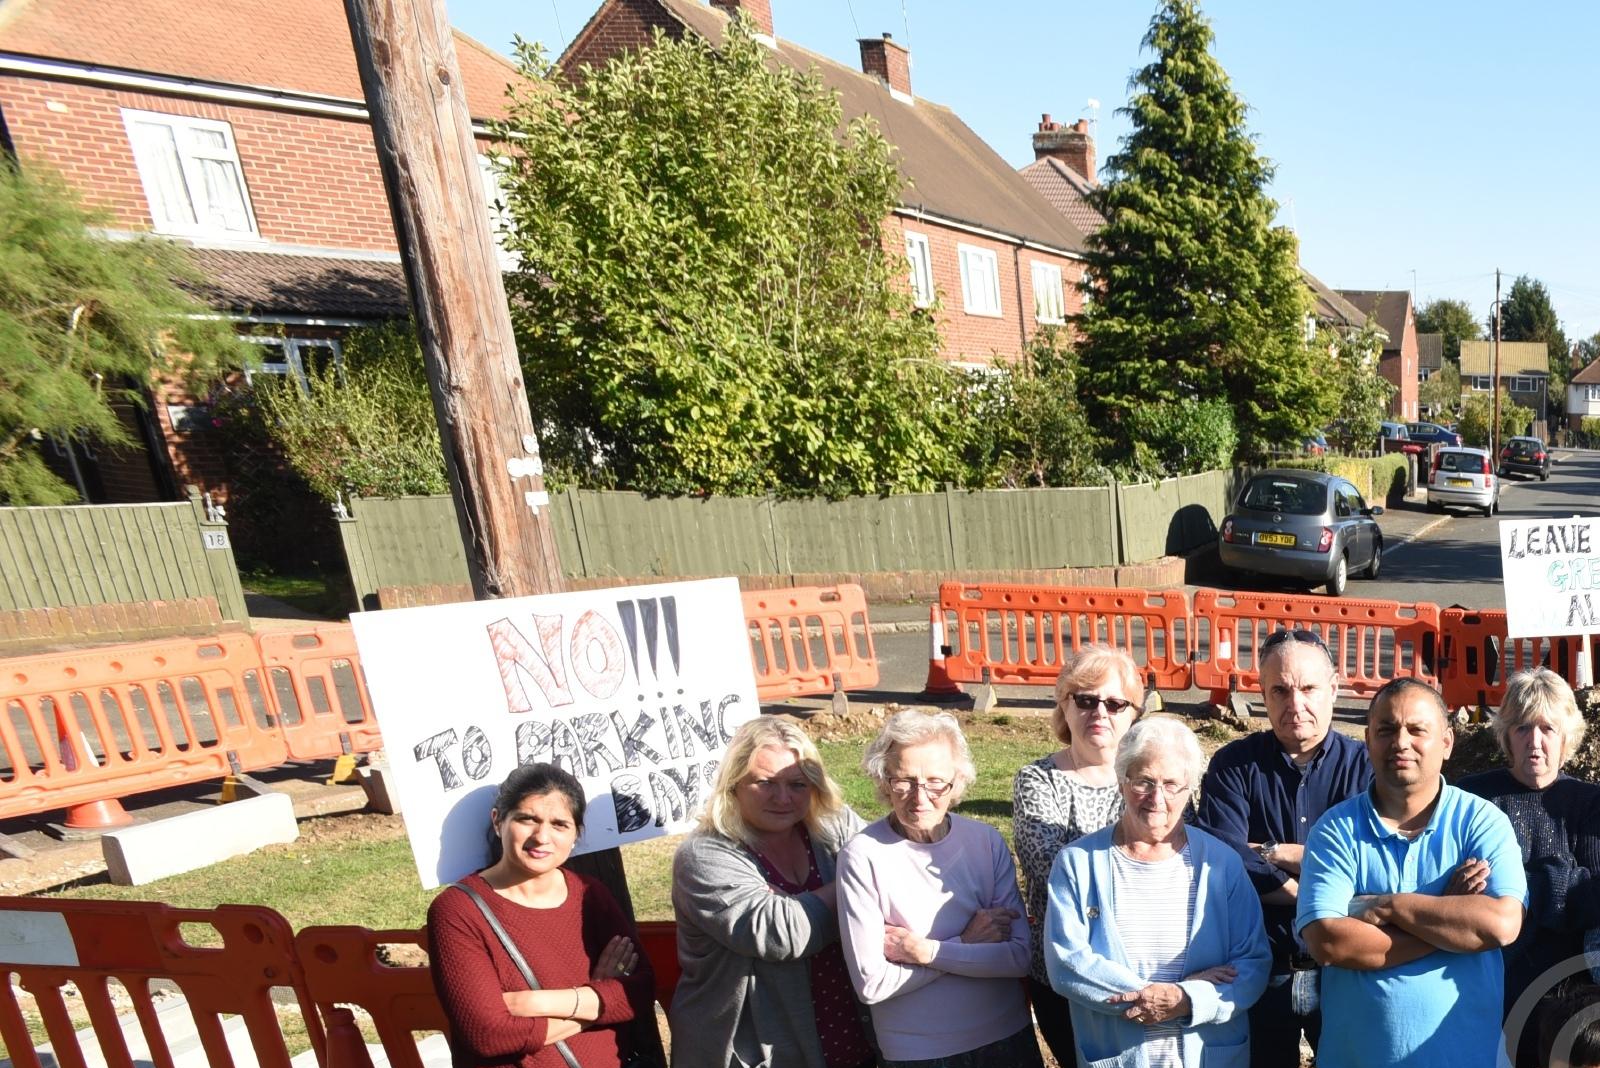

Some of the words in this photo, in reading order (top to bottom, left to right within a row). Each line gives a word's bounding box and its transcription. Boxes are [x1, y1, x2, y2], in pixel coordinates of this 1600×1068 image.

[208, 534, 226, 546] 18
[1508, 523, 1592, 559] LEAVE
[486, 595, 687, 714] NO!!!
[413, 725, 493, 793] TO
[515, 693, 741, 779] PARKING
